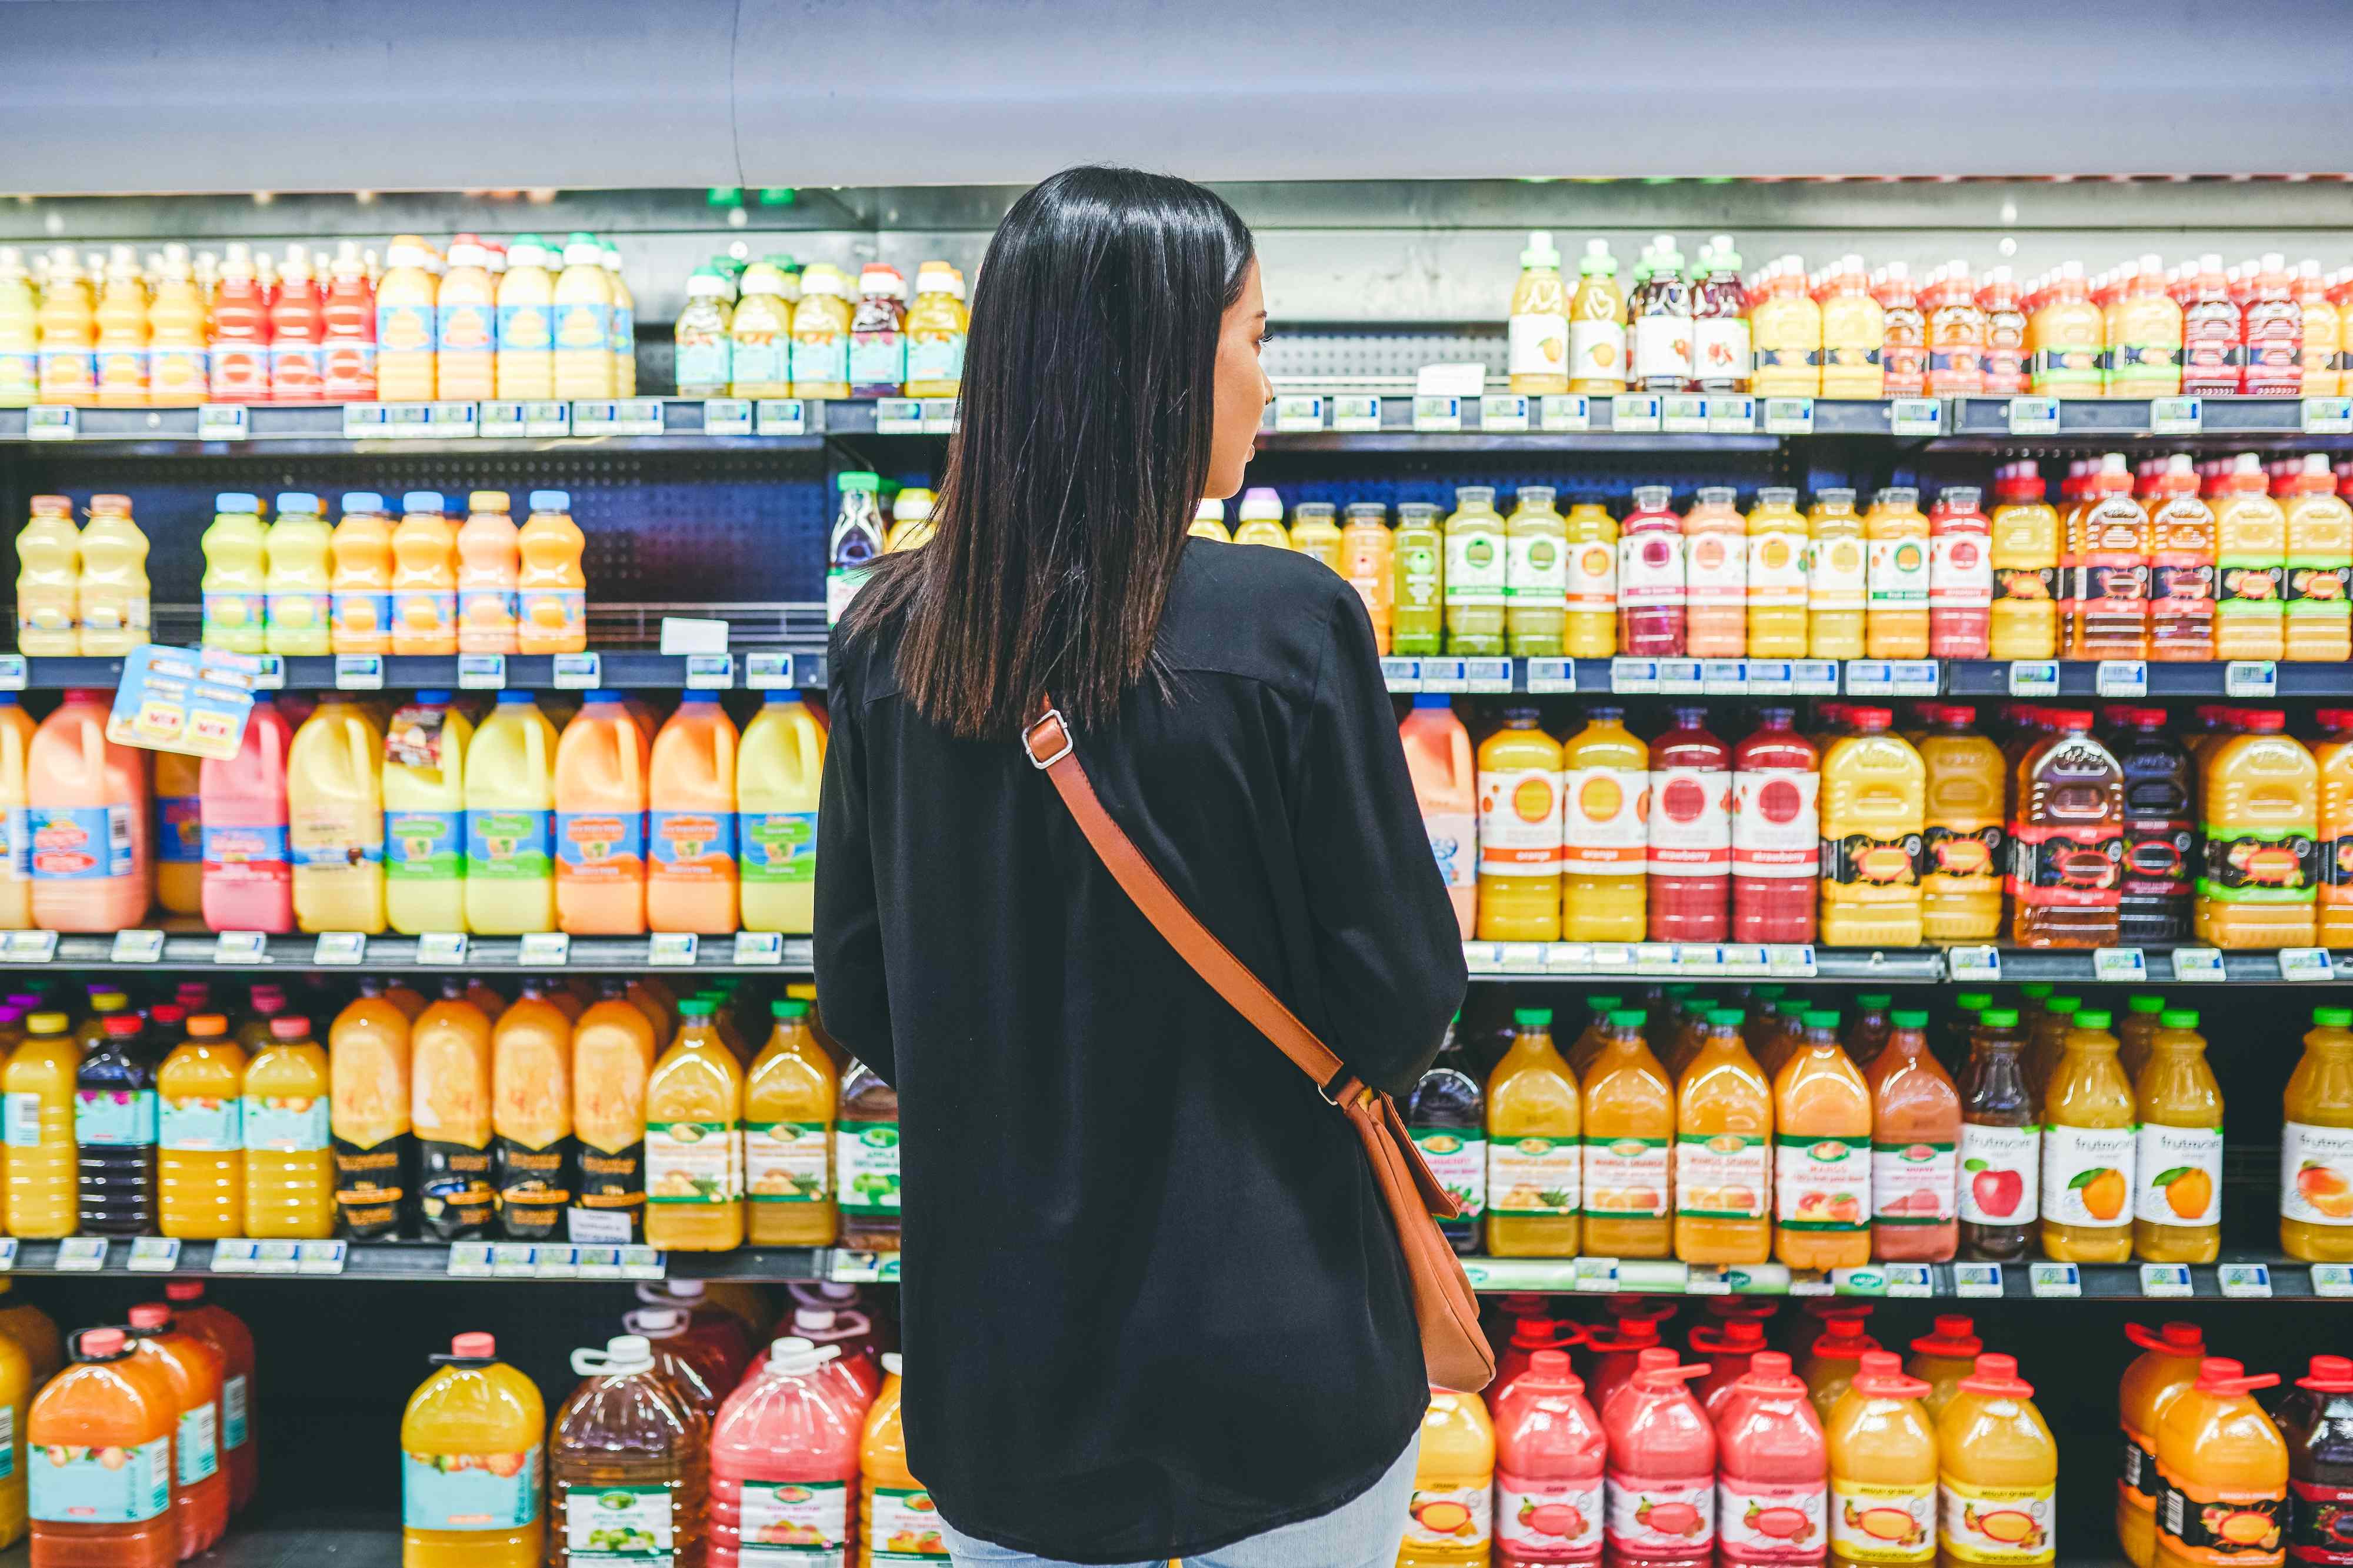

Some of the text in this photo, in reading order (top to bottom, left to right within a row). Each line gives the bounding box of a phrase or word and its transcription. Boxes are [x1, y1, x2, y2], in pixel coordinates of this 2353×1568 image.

[1516, 851, 1551, 862] orange
[1581, 850, 1618, 862] orange
[1657, 850, 1711, 864] strawberry
[1752, 851, 1806, 865] strawberry
